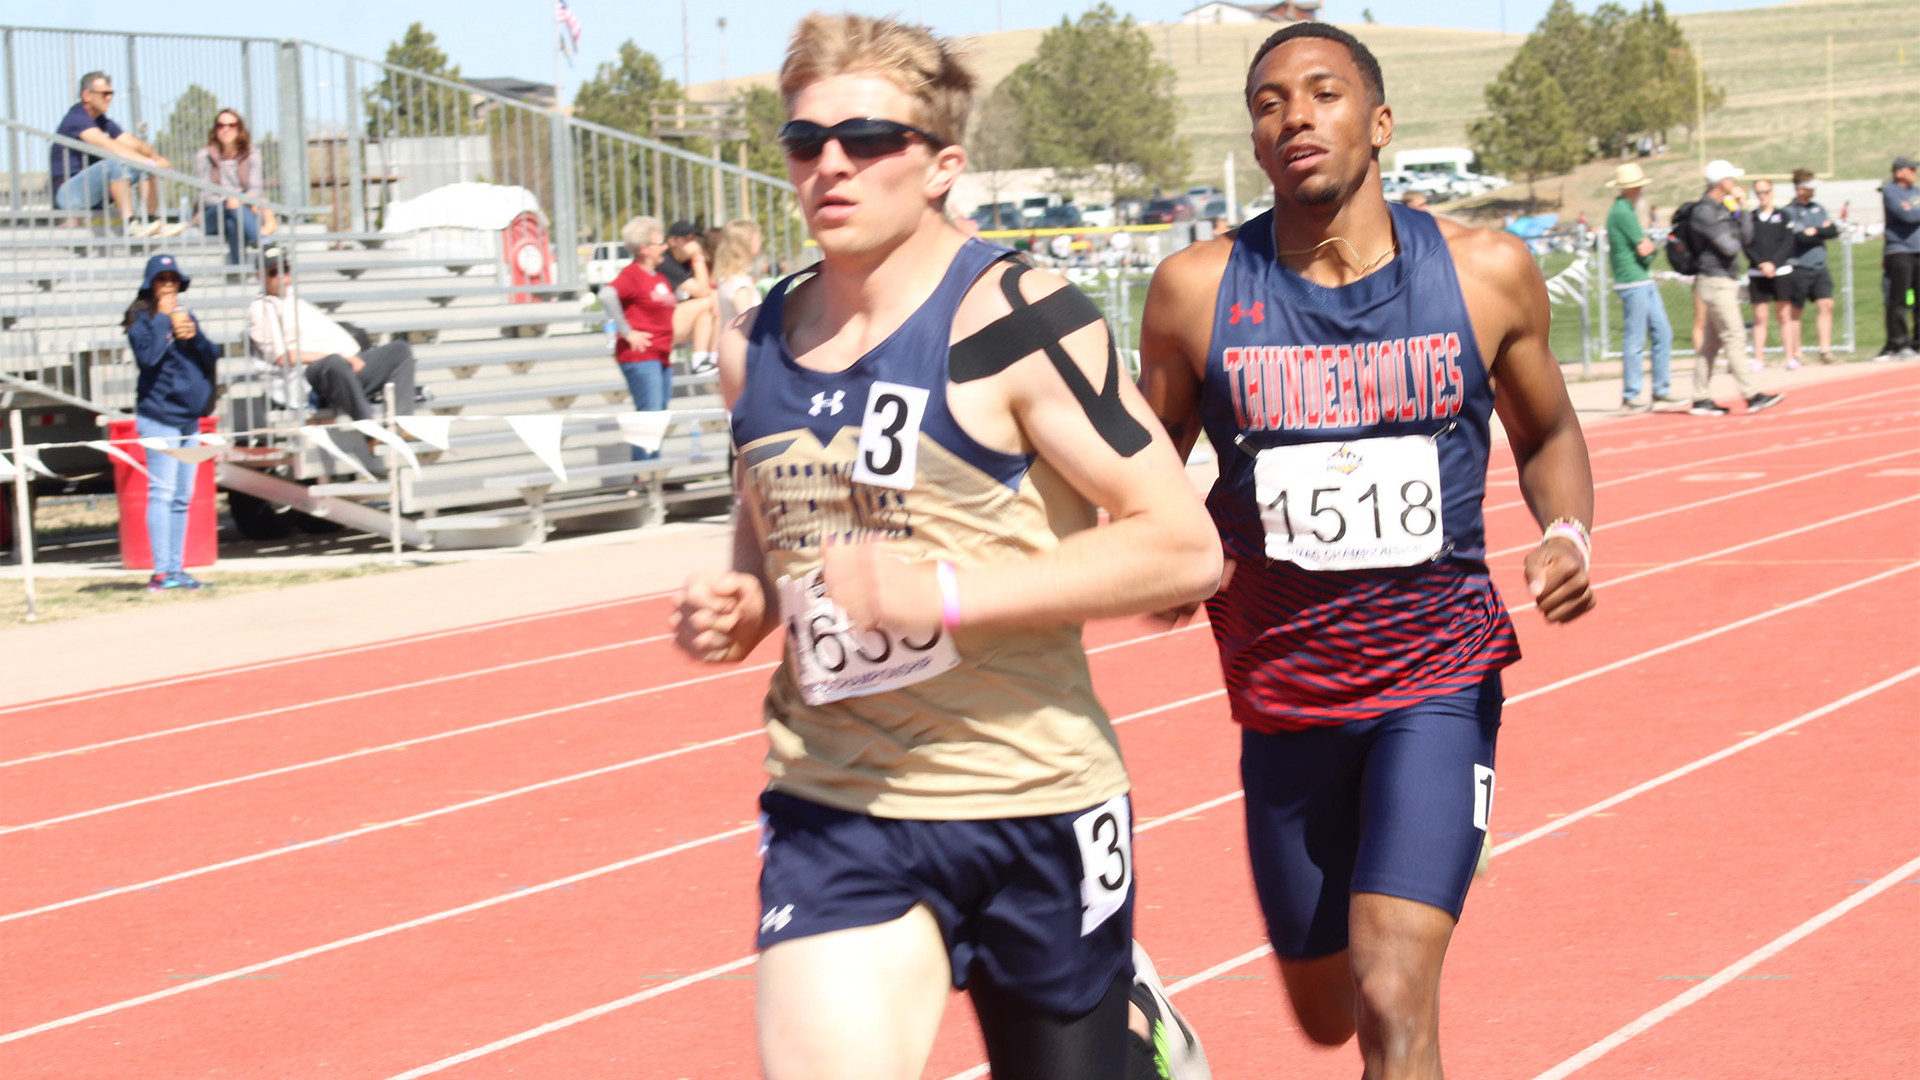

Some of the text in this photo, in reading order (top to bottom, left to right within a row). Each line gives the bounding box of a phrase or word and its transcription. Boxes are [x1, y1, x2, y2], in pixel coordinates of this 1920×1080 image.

[1223, 333, 1464, 431] THUNDERWOLVES
[864, 393, 909, 476] 3
[1267, 480, 1437, 543] 1518
[1479, 773, 1493, 826] 1
[1092, 812, 1126, 891] 3
